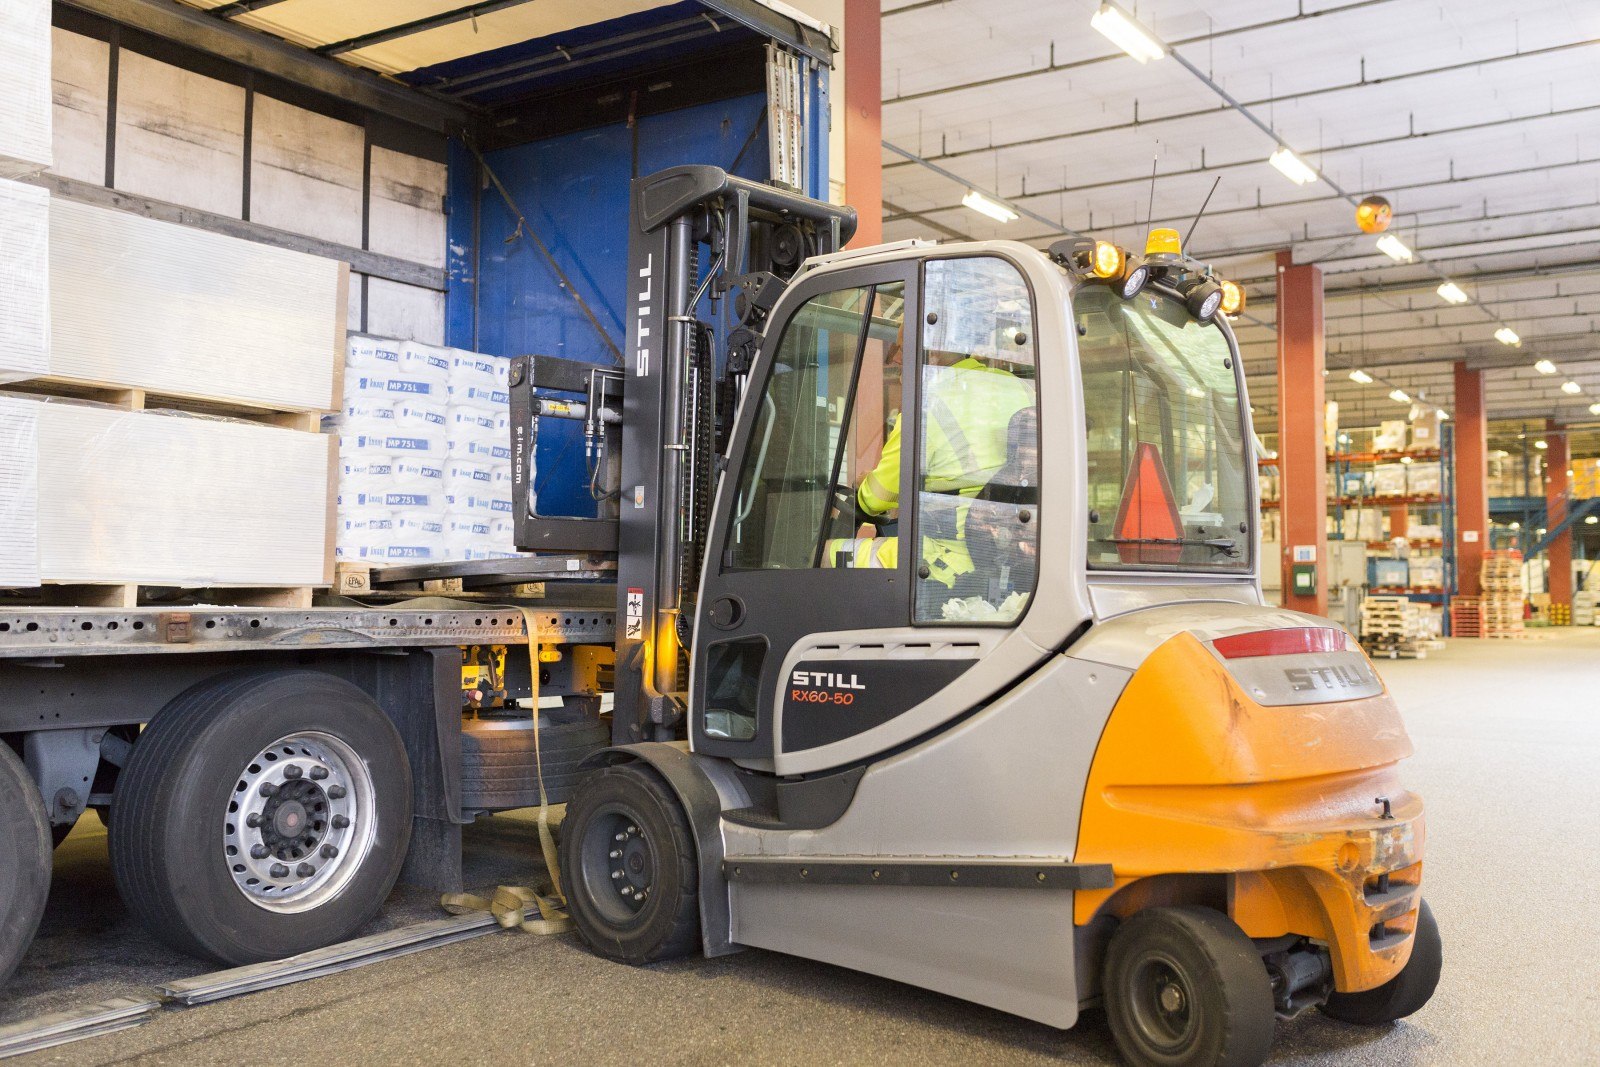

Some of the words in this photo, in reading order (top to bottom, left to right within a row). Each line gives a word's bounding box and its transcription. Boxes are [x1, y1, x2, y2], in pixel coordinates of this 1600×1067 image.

[636, 254, 652, 376] STILL
[793, 671, 865, 689] STILL
[1284, 664, 1370, 691] STILL
[792, 690, 854, 705] RX60-50
